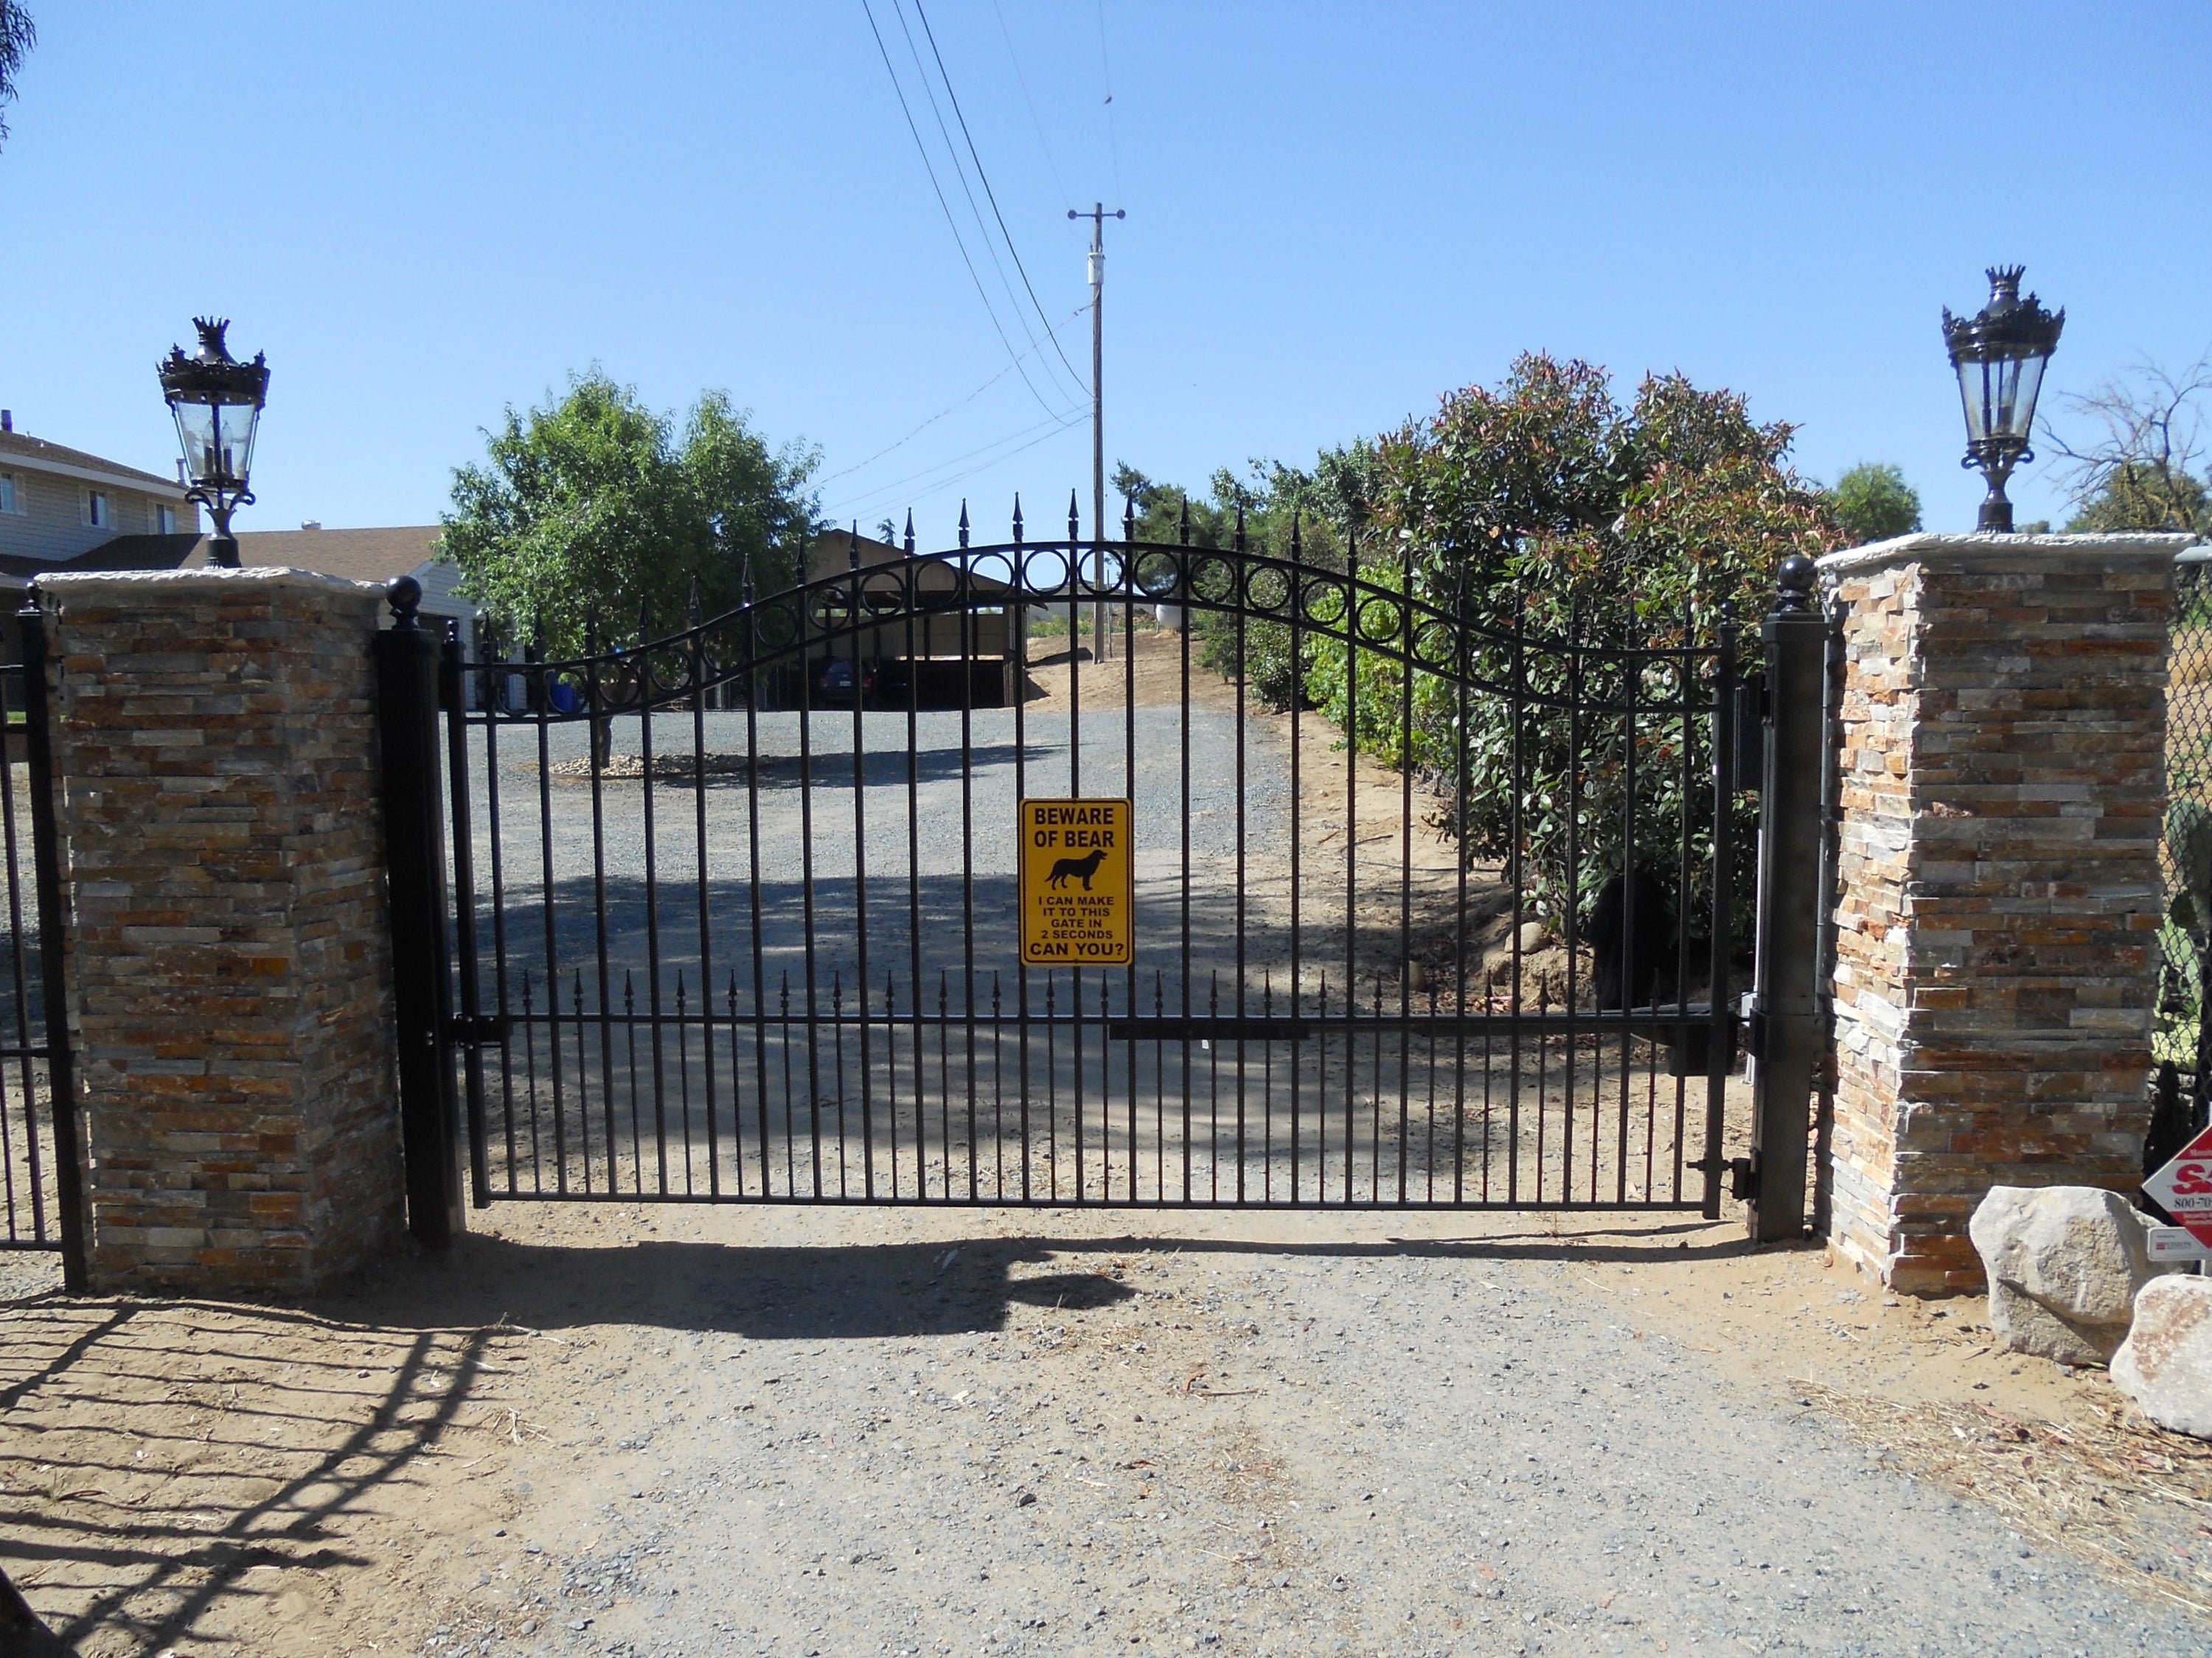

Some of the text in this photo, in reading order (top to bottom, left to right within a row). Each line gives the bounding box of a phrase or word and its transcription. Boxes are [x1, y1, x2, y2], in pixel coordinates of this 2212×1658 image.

[1034, 808, 1114, 825] BEWARE
[1034, 830, 1114, 847] OF BEAR
[1038, 896, 1114, 906] I CAN MAKE
[1043, 907, 1110, 917] IT TO THIS
[1051, 918, 1102, 928] GATE IN
[1041, 930, 1113, 940] 2 SECONDS
[1029, 942, 1124, 956] CAN YOU?
[2174, 1197, 2212, 1209] 800-70
